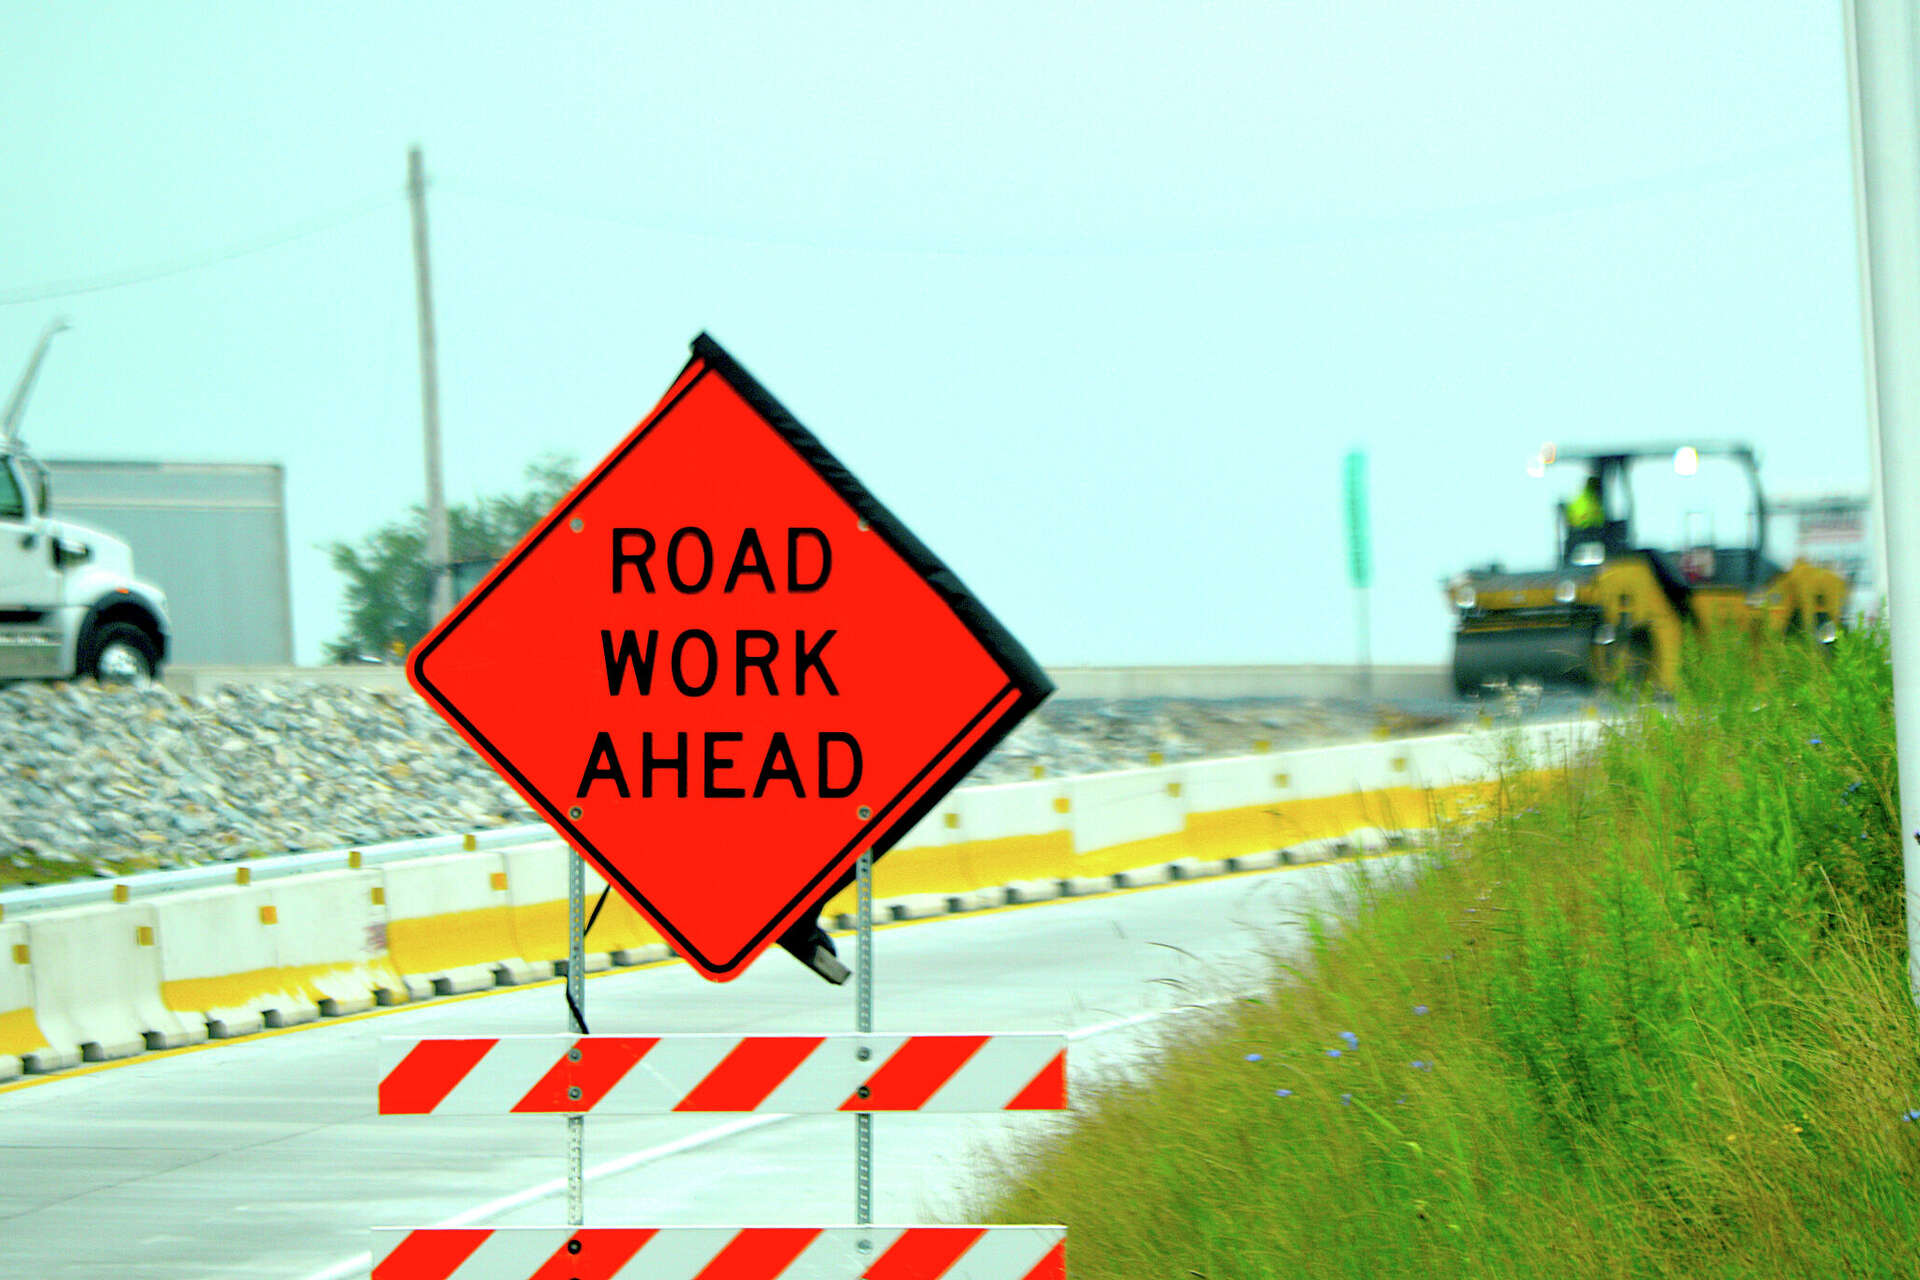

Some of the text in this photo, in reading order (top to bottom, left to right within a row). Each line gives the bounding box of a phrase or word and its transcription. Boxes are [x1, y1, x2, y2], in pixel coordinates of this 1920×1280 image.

[612, 527, 832, 594] ROAD
[601, 629, 839, 697] WORK
[576, 731, 863, 799] AHEAD
